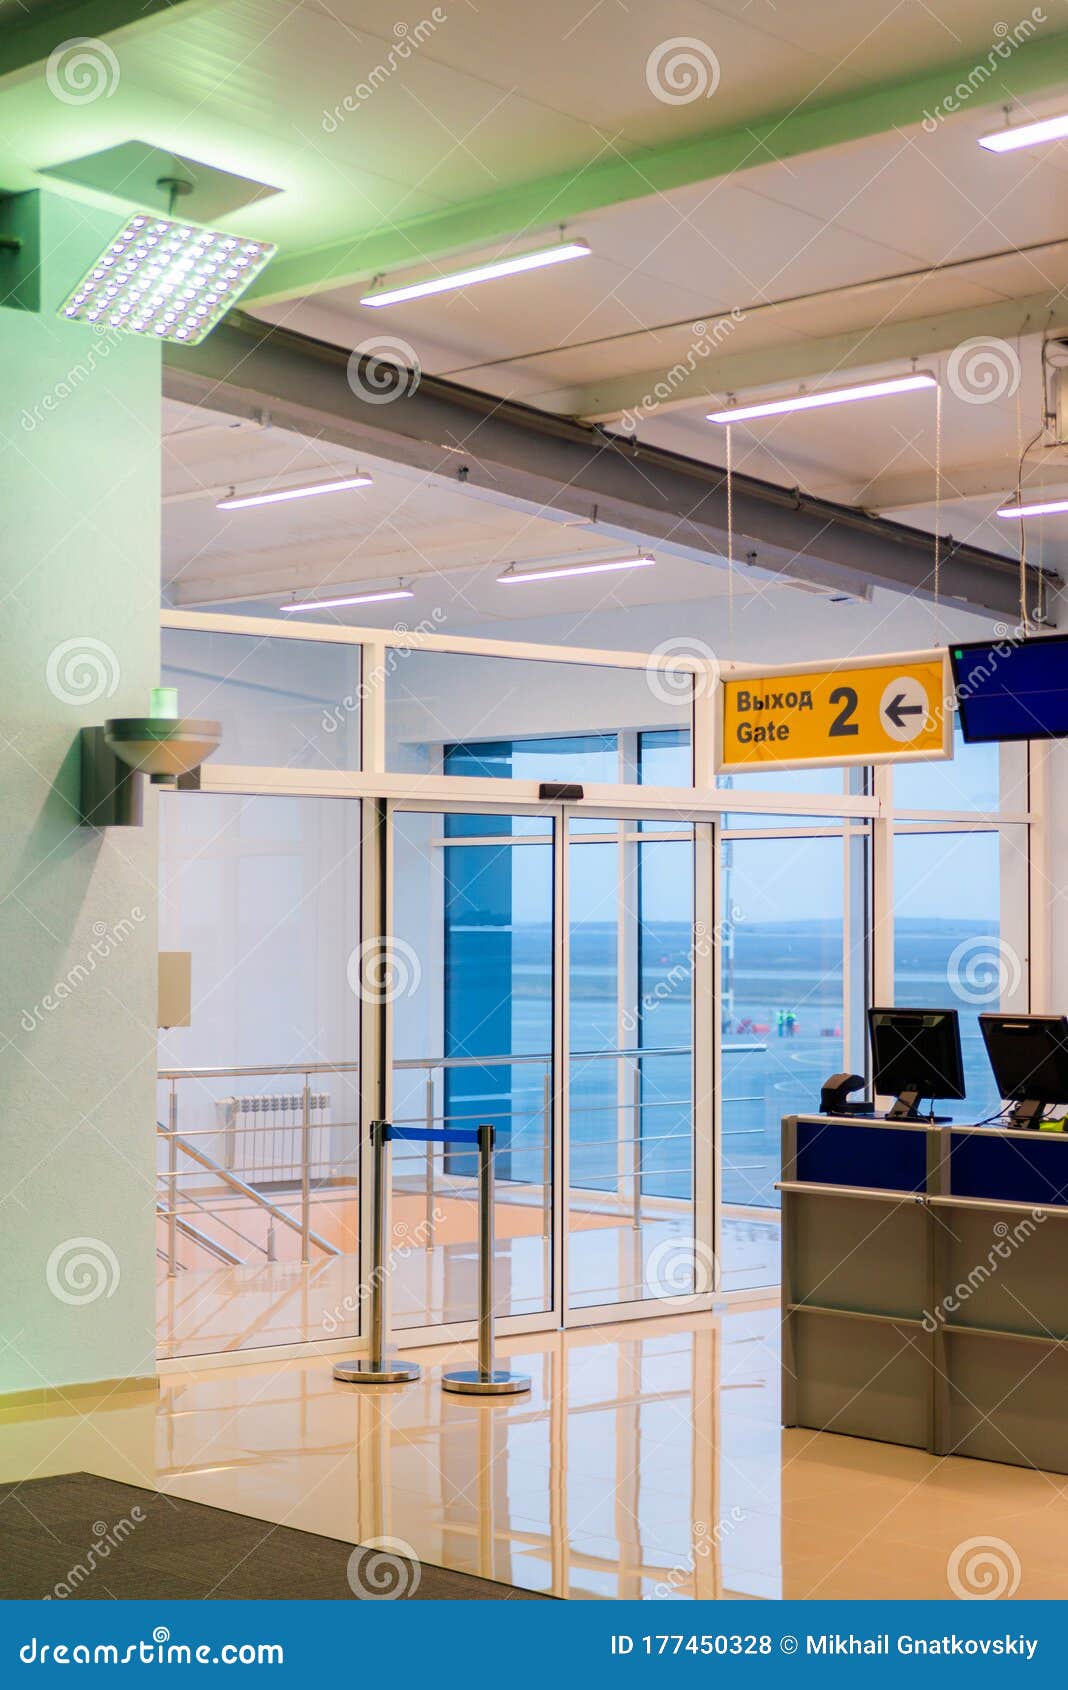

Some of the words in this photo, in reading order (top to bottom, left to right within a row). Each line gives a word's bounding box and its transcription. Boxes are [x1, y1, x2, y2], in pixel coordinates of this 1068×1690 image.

[737, 690, 813, 712] Выход
[828, 686, 859, 737] 2
[737, 721, 790, 744] Gate
